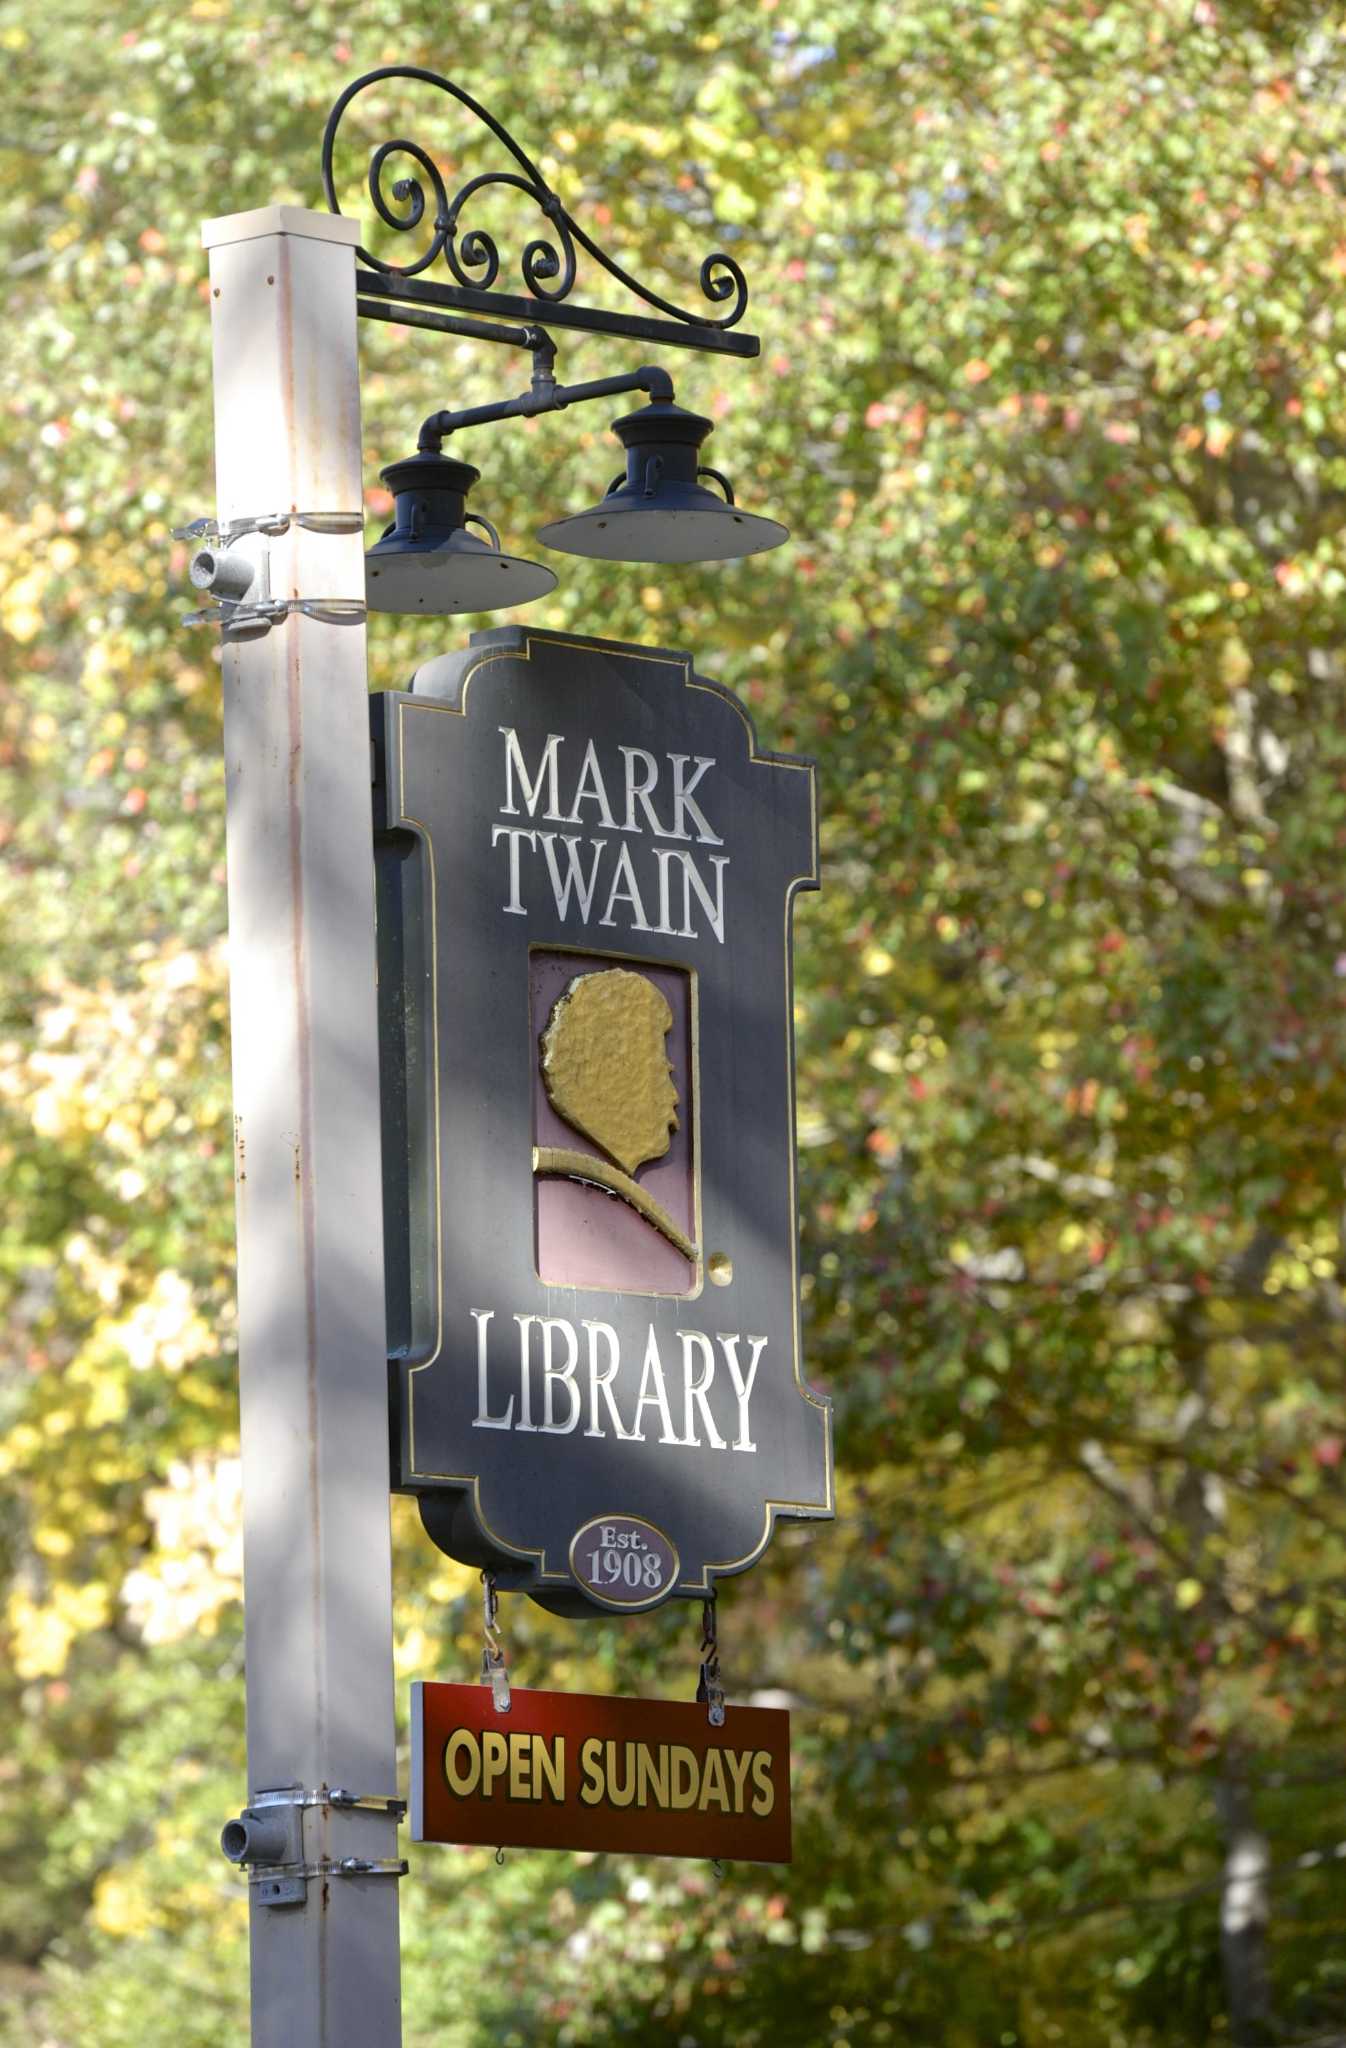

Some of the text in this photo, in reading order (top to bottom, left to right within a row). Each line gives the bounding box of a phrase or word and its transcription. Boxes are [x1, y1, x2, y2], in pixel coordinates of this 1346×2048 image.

[498, 726, 725, 846] MARK
[491, 823, 730, 944] TWAIN
[470, 1308, 768, 1452] LIBRARY
[586, 1549, 662, 1589] 1908
[599, 1526, 649, 1551] Est.
[445, 1728, 775, 1816] OPEN SUNDAYS
